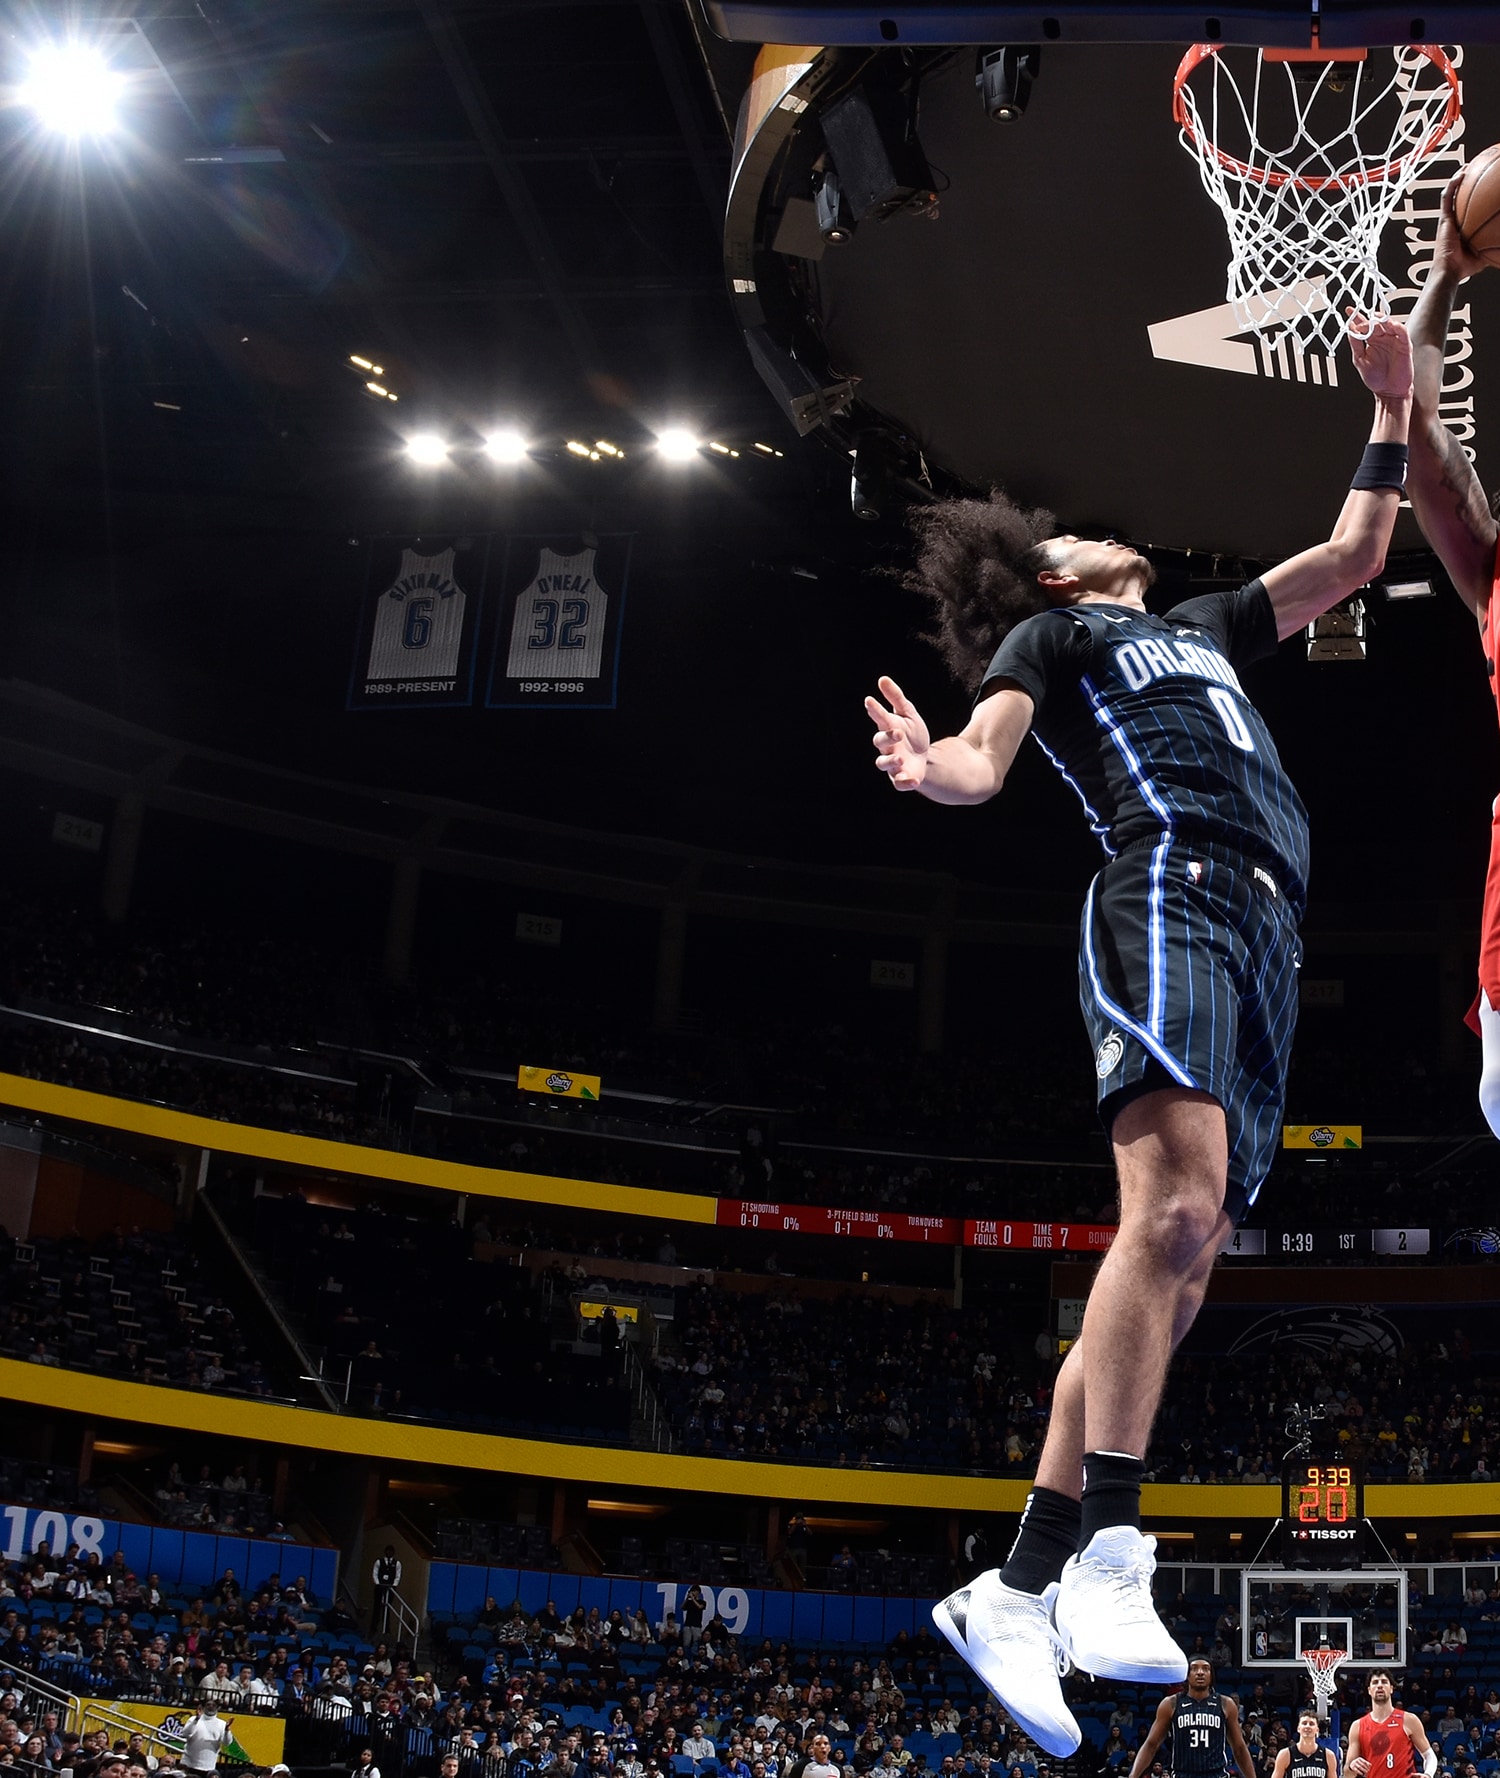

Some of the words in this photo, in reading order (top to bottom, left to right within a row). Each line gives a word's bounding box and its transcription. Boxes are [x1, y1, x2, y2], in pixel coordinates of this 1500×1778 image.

[537, 574, 588, 594] O'NEAL
[402, 597, 434, 649] 6
[528, 598, 590, 650] 32
[364, 681, 456, 694] 1989-PRESENT
[519, 682, 585, 693] 1992-1996
[1207, 686, 1255, 752] 0
[62, 821, 94, 841] 214
[525, 920, 553, 935] 215
[880, 966, 906, 980] 216
[1308, 984, 1335, 998] 217
[741, 1202, 749, 1211] FT
[750, 1203, 779, 1215] SHOOTING
[827, 1209, 842, 1220] 3-PT
[842, 1210, 859, 1222] FIELD
[860, 1211, 879, 1223] GOALS
[783, 1216, 800, 1231] 0%
[908, 1216, 944, 1228] TURNOVERS
[975, 1221, 997, 1233] TEAM
[1033, 1223, 1052, 1236] TIME
[877, 1224, 894, 1238] 0%
[1003, 1225, 1012, 1245] 0
[1060, 1227, 1069, 1247] 7
[973, 1233, 998, 1246] FOULS
[1032, 1235, 1052, 1247] OUTS
[1232, 1231, 1242, 1250] 4
[1282, 1233, 1313, 1251] 9:39
[1338, 1234, 1356, 1249] 1ST
[1398, 1231, 1407, 1250] 2
[1307, 1468, 1351, 1486] 9:39
[1299, 1487, 1347, 1522] 20
[2, 1506, 105, 1565] 108
[1309, 1529, 1357, 1539] TISSOT
[1177, 1713, 1221, 1728] ORLANDO
[1190, 1729, 1209, 1747] 34
[1386, 1753, 1394, 1769] 8
[1291, 1766, 1326, 1778] ORLANDO
